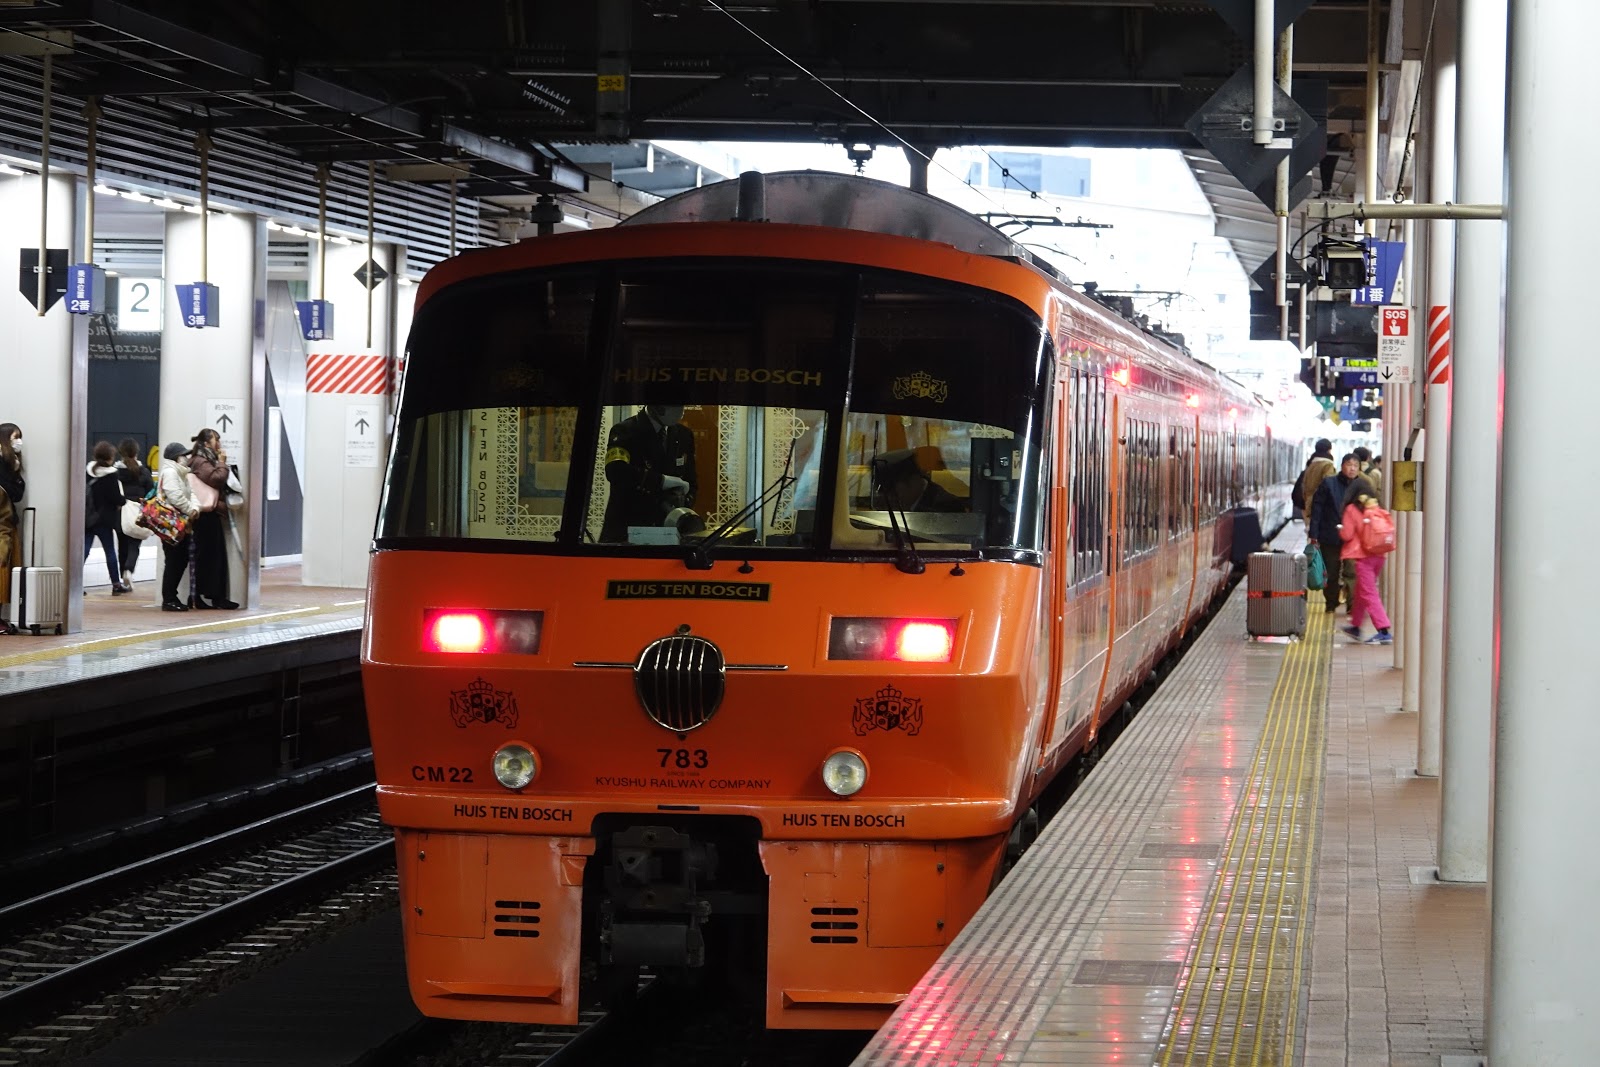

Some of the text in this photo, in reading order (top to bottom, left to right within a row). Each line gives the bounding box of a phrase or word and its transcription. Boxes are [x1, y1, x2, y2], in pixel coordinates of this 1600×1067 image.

[130, 282, 150, 312] 2
[1359, 287, 1384, 302] 1番
[70, 299, 91, 311] 2番
[187, 314, 206, 326] 3番
[1385, 310, 1407, 320] SOS
[306, 329, 324, 340] 4番
[1381, 338, 1406, 346] 非常停止
[614, 367, 822, 386] HUIS TEN BOSCH
[616, 584, 761, 598] HUIS TEN BOSCH
[656, 748, 709, 769] 783
[595, 776, 772, 789] KYUSHU RAILWAY COMPANY
[454, 804, 573, 822] HUIS TEN BOSCH
[782, 813, 905, 828] HUIS TEN BOSCH
